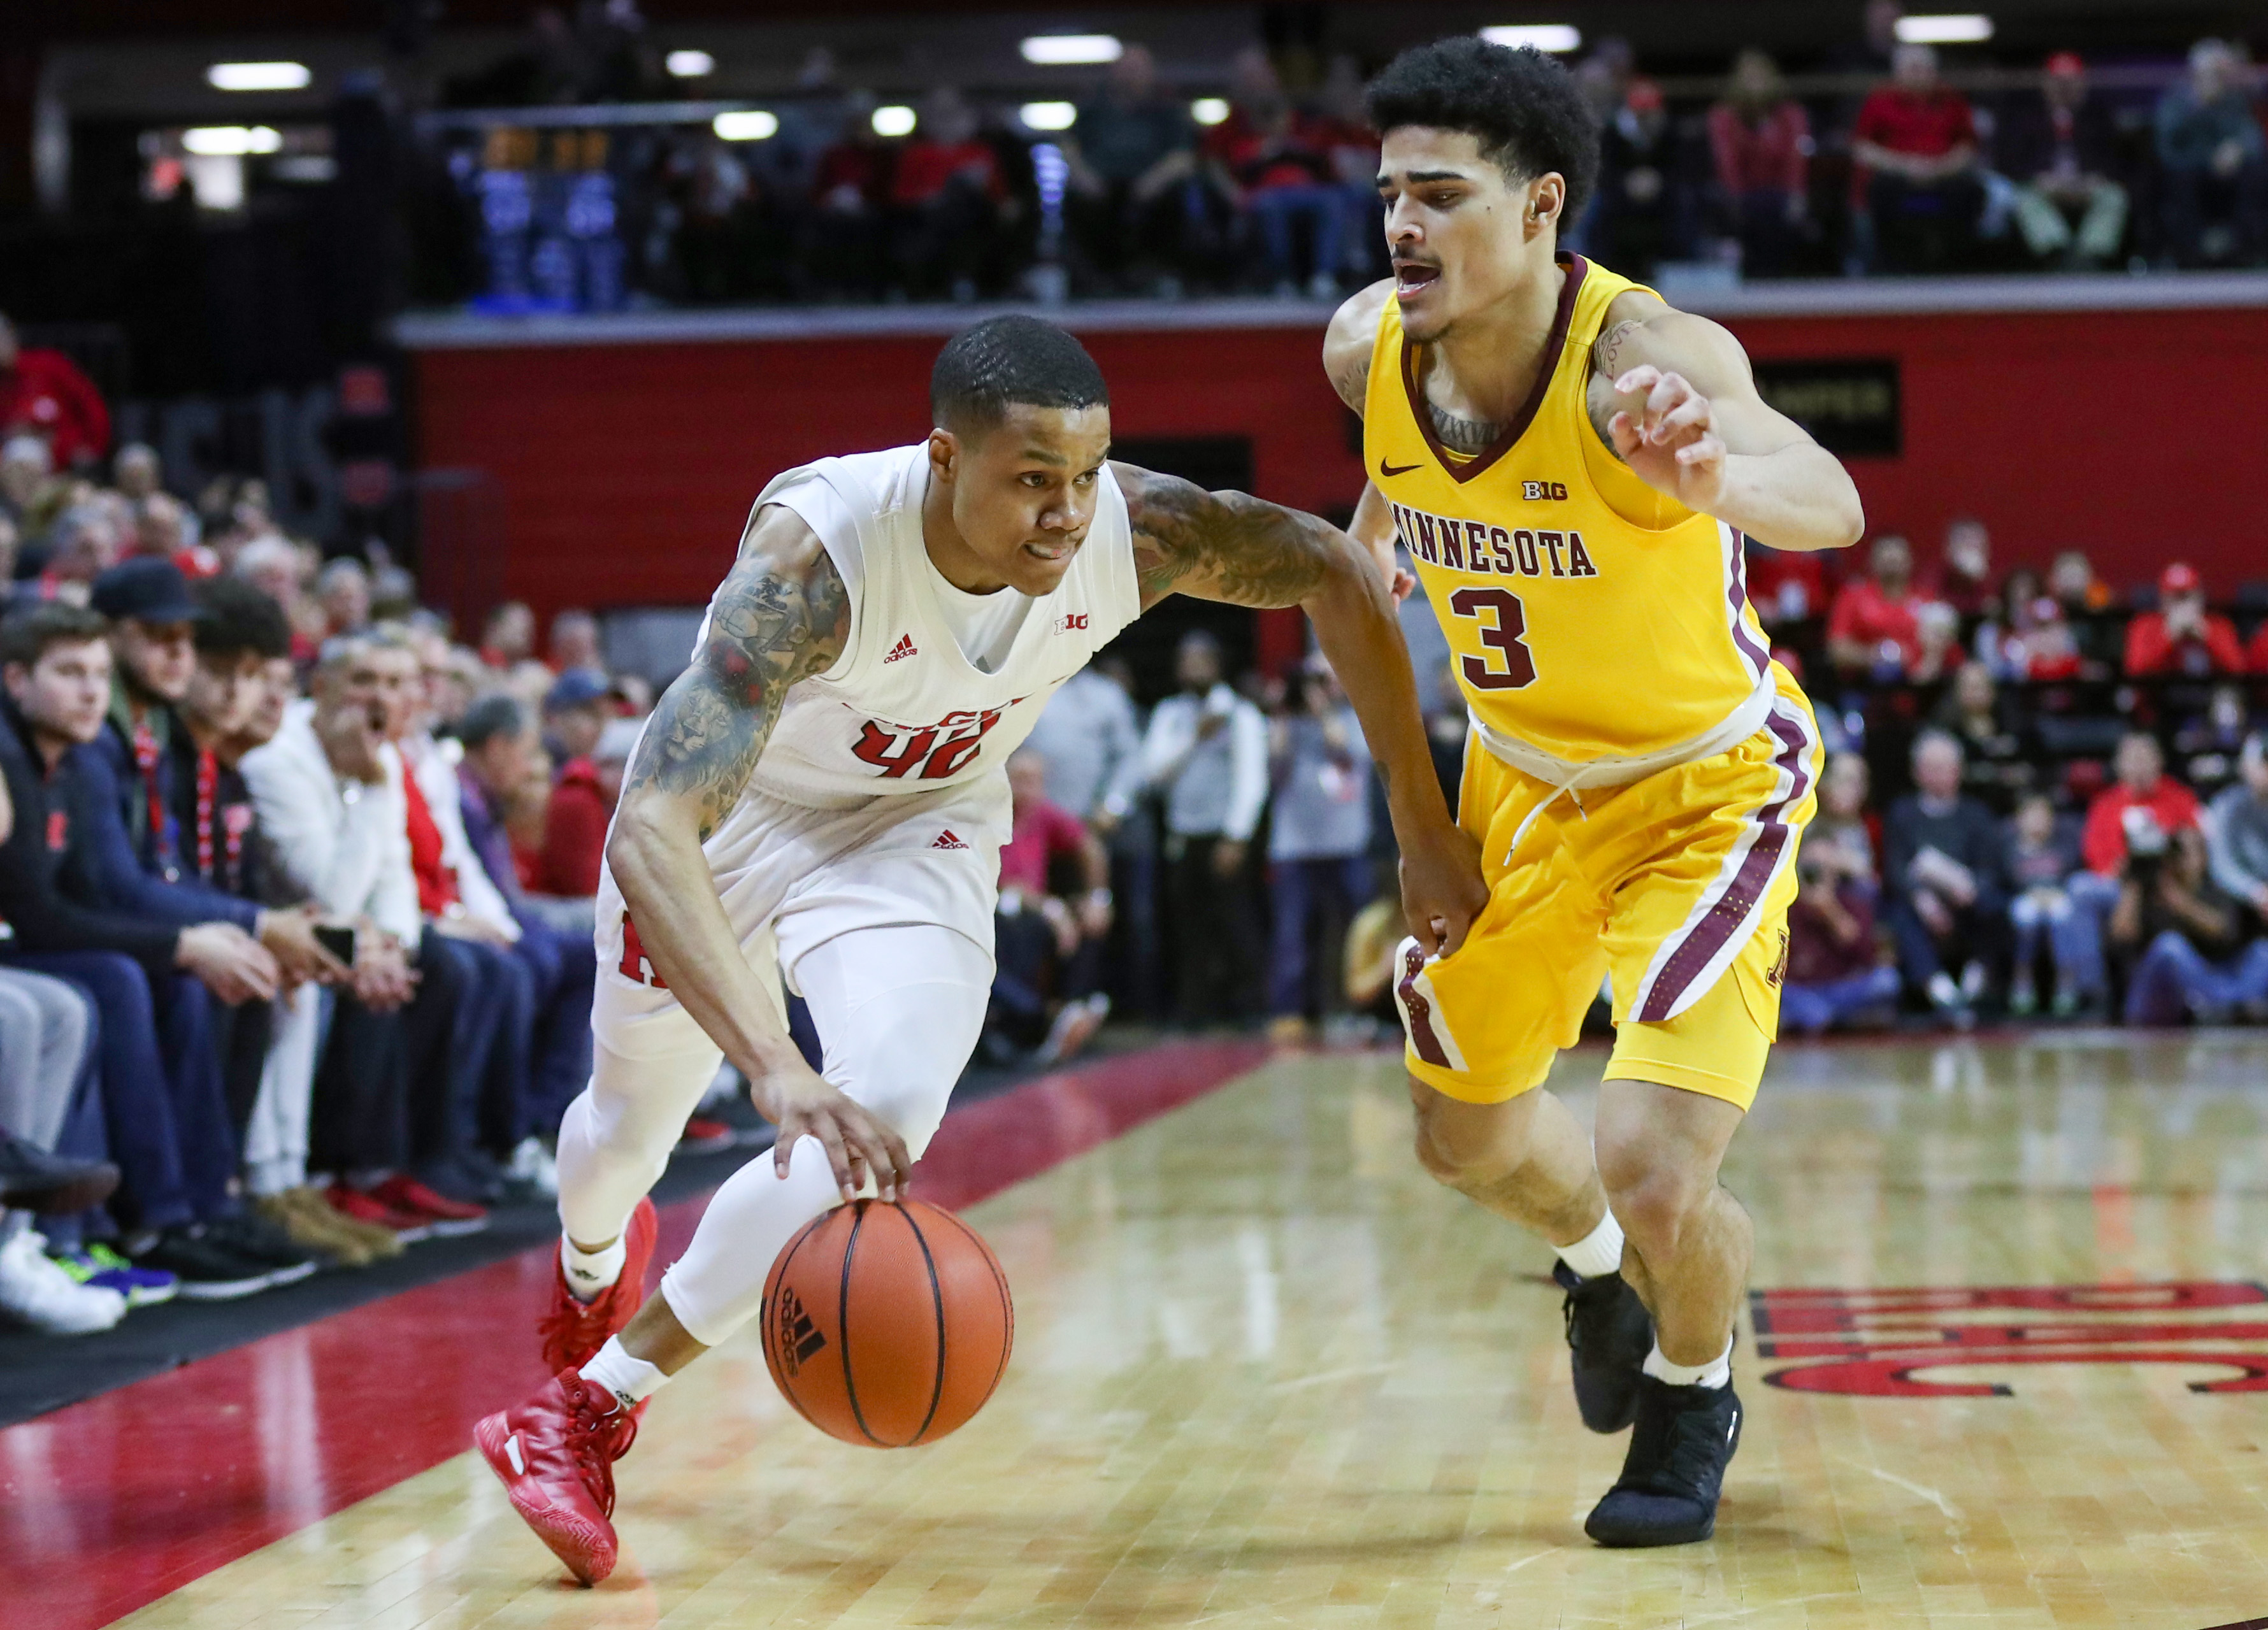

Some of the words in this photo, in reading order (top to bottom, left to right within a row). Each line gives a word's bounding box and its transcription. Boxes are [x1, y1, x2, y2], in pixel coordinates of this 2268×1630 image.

[884, 648, 917, 664] adidas
[1449, 586, 1539, 690] 3
[781, 1287, 799, 1378] adidas
